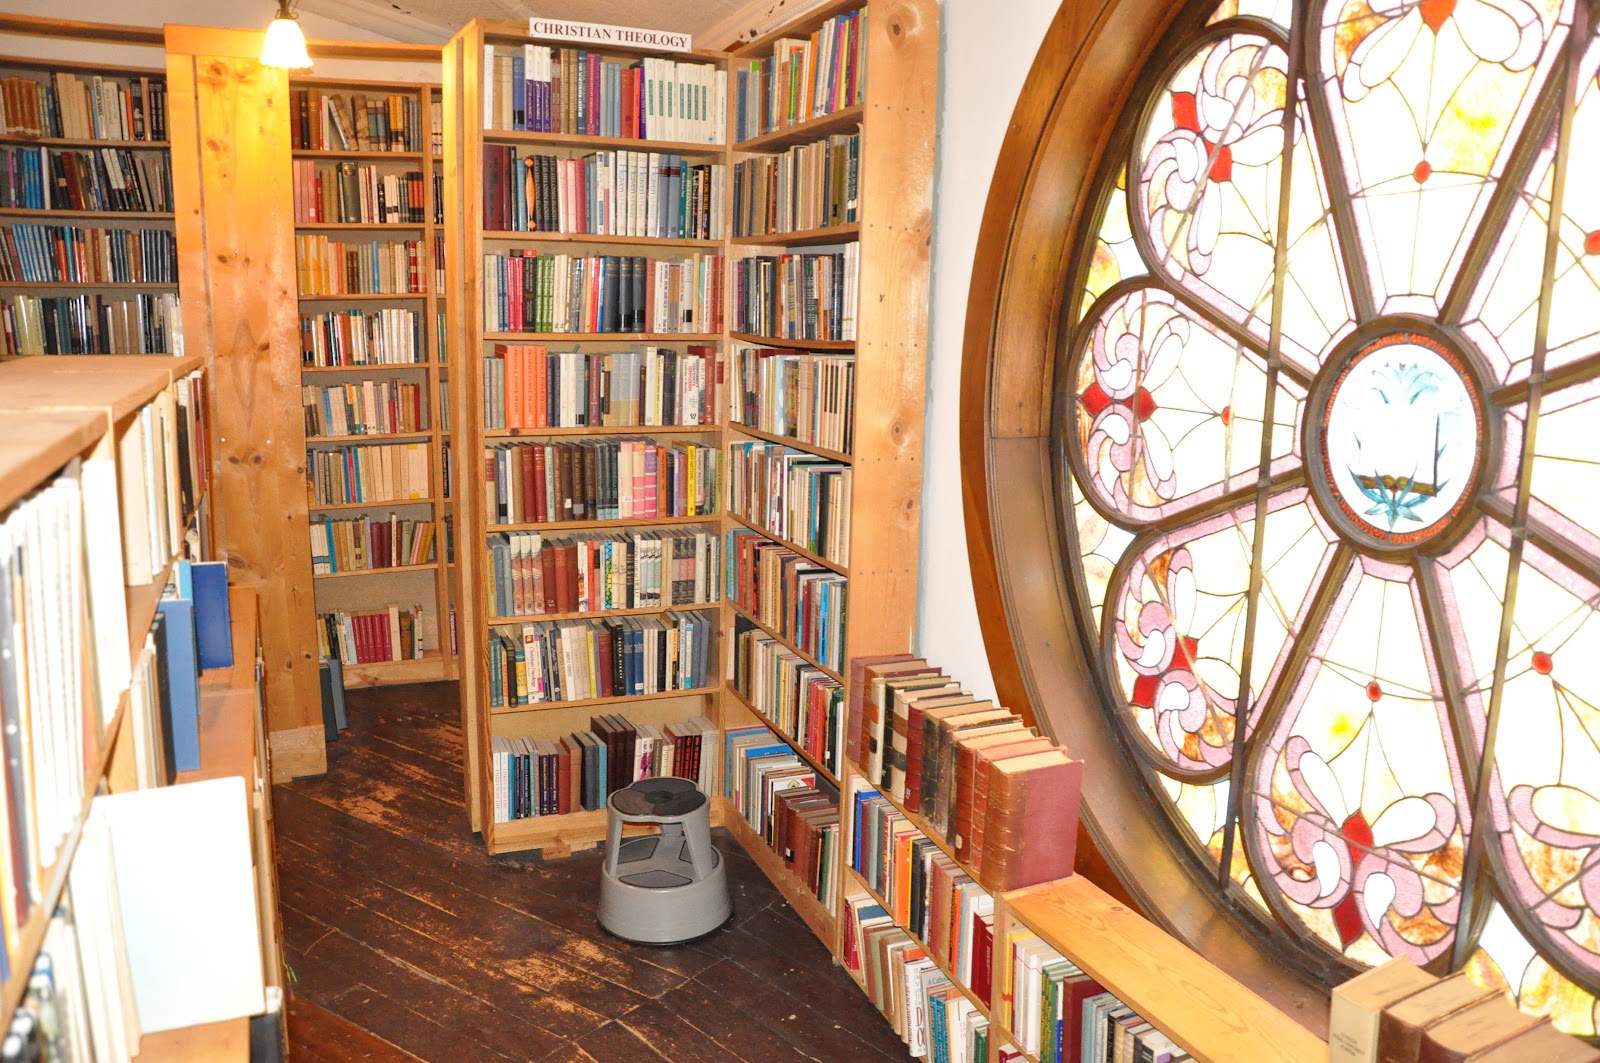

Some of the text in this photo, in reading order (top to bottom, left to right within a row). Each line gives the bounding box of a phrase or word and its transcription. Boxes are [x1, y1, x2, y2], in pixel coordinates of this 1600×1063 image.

[534, 22, 688, 48] CHRISTIAN THEOLOGY
[619, 164, 628, 192] Heaven
[629, 166, 638, 194] Heaven
[640, 167, 649, 195] Heaven
